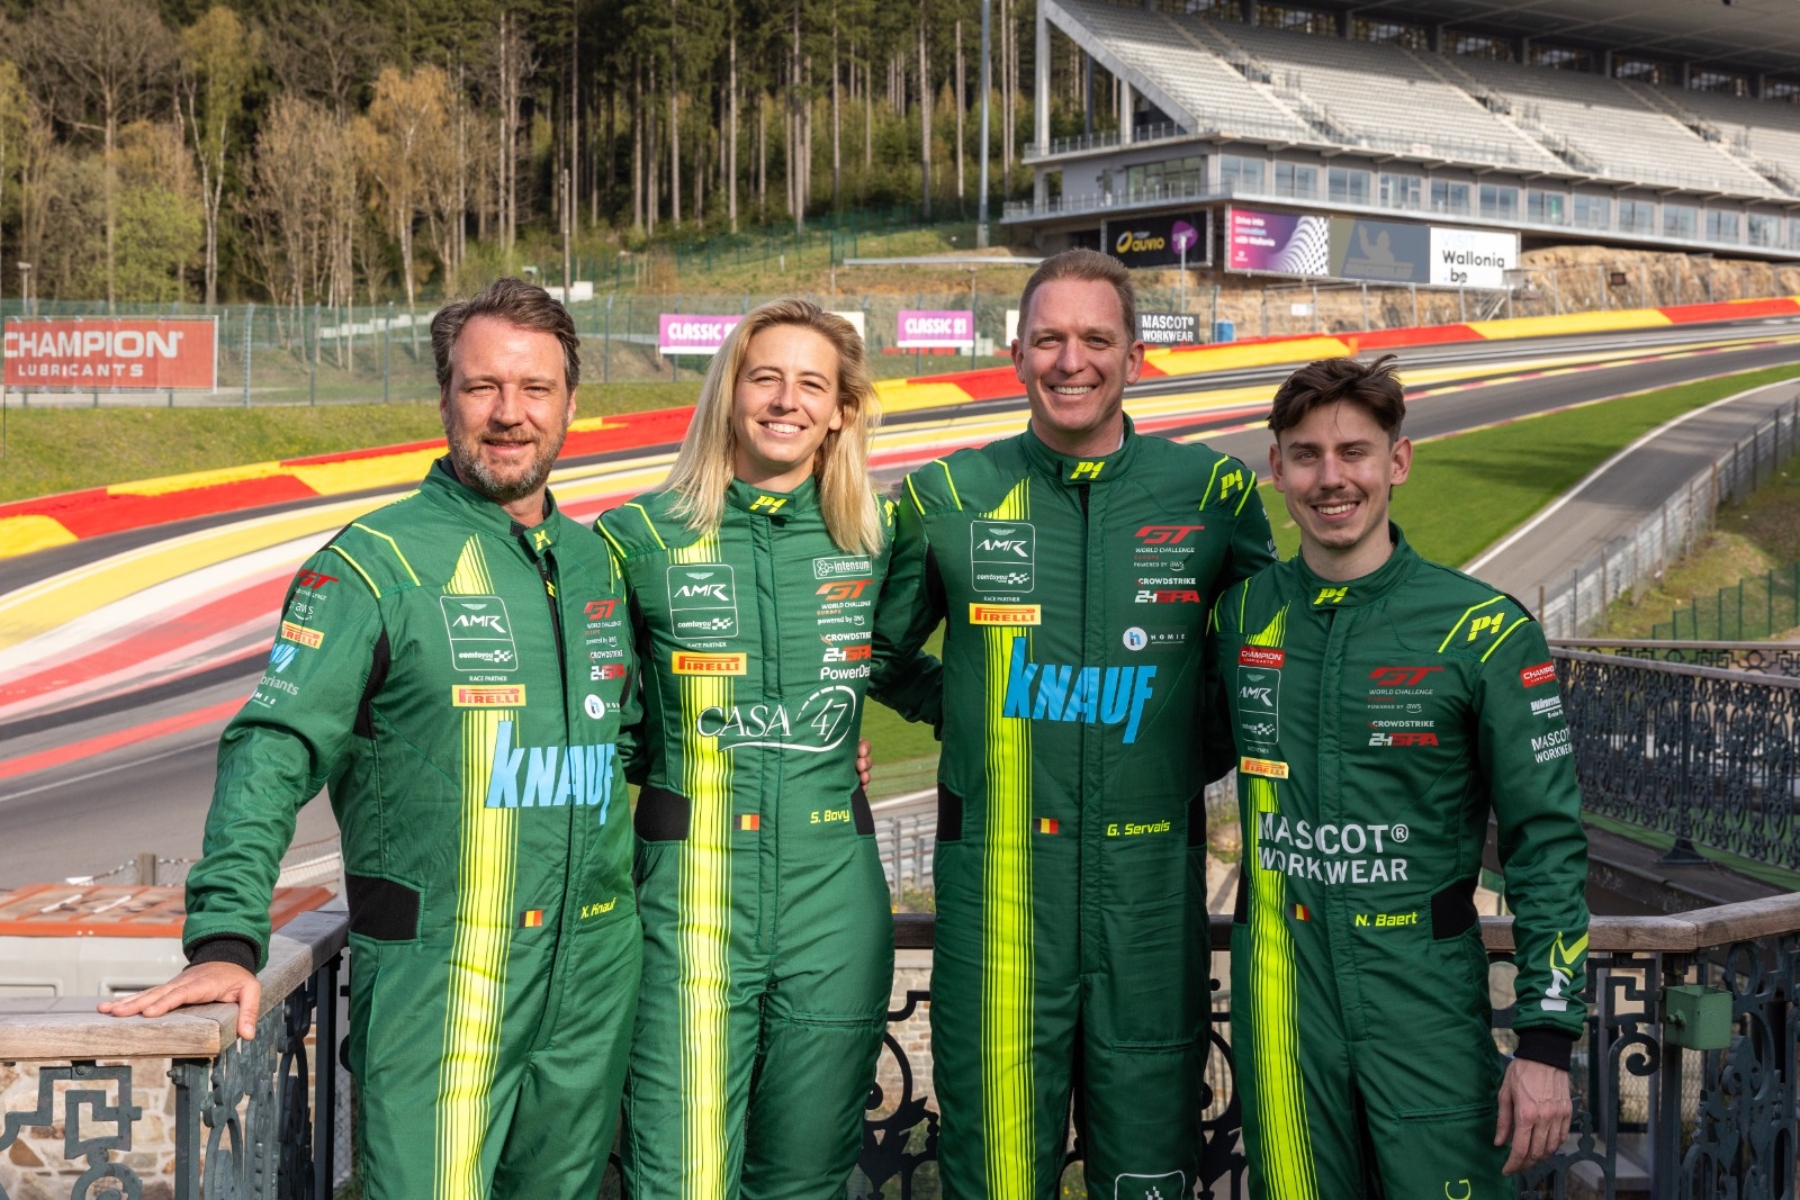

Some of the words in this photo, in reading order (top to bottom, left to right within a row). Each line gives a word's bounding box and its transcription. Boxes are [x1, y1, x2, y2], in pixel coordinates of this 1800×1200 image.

[1442, 250, 1505, 268] Wallonia
[667, 322, 722, 340] CLASSIC
[905, 318, 952, 334] CLASSIC
[953, 317, 967, 334] 21
[1142, 330, 1193, 342] WORKWEAR
[18, 364, 144, 378] LUBRICANTS
[1070, 461, 1106, 480] P1
[1220, 469, 1244, 500] P1
[748, 494, 788, 514] P1
[1134, 525, 1205, 545] GT
[975, 539, 1029, 558] AMR
[815, 579, 874, 601] GT
[1137, 577, 1197, 585] CROWDSTRIKE
[673, 584, 730, 602] AMR
[1313, 586, 1349, 605] P1
[583, 598, 622, 621] GT
[975, 607, 1036, 622] PIRELLI
[452, 614, 506, 634] AMR
[1467, 612, 1505, 642] P1
[679, 655, 740, 671] PIRELLI
[1368, 666, 1445, 687] GT
[458, 688, 520, 704] PIRELLI
[697, 704, 792, 738] CASA
[810, 698, 848, 743] 47
[1371, 720, 1435, 728] CROWDSTRIKE
[1244, 759, 1286, 777] PIRELLI
[810, 810, 821, 825] S.
[1106, 823, 1121, 837] G.
[1124, 819, 1171, 837] Servais
[1257, 846, 1409, 886] WORKWEAR
[1355, 914, 1371, 927] N.
[1375, 911, 1418, 927] Baert
